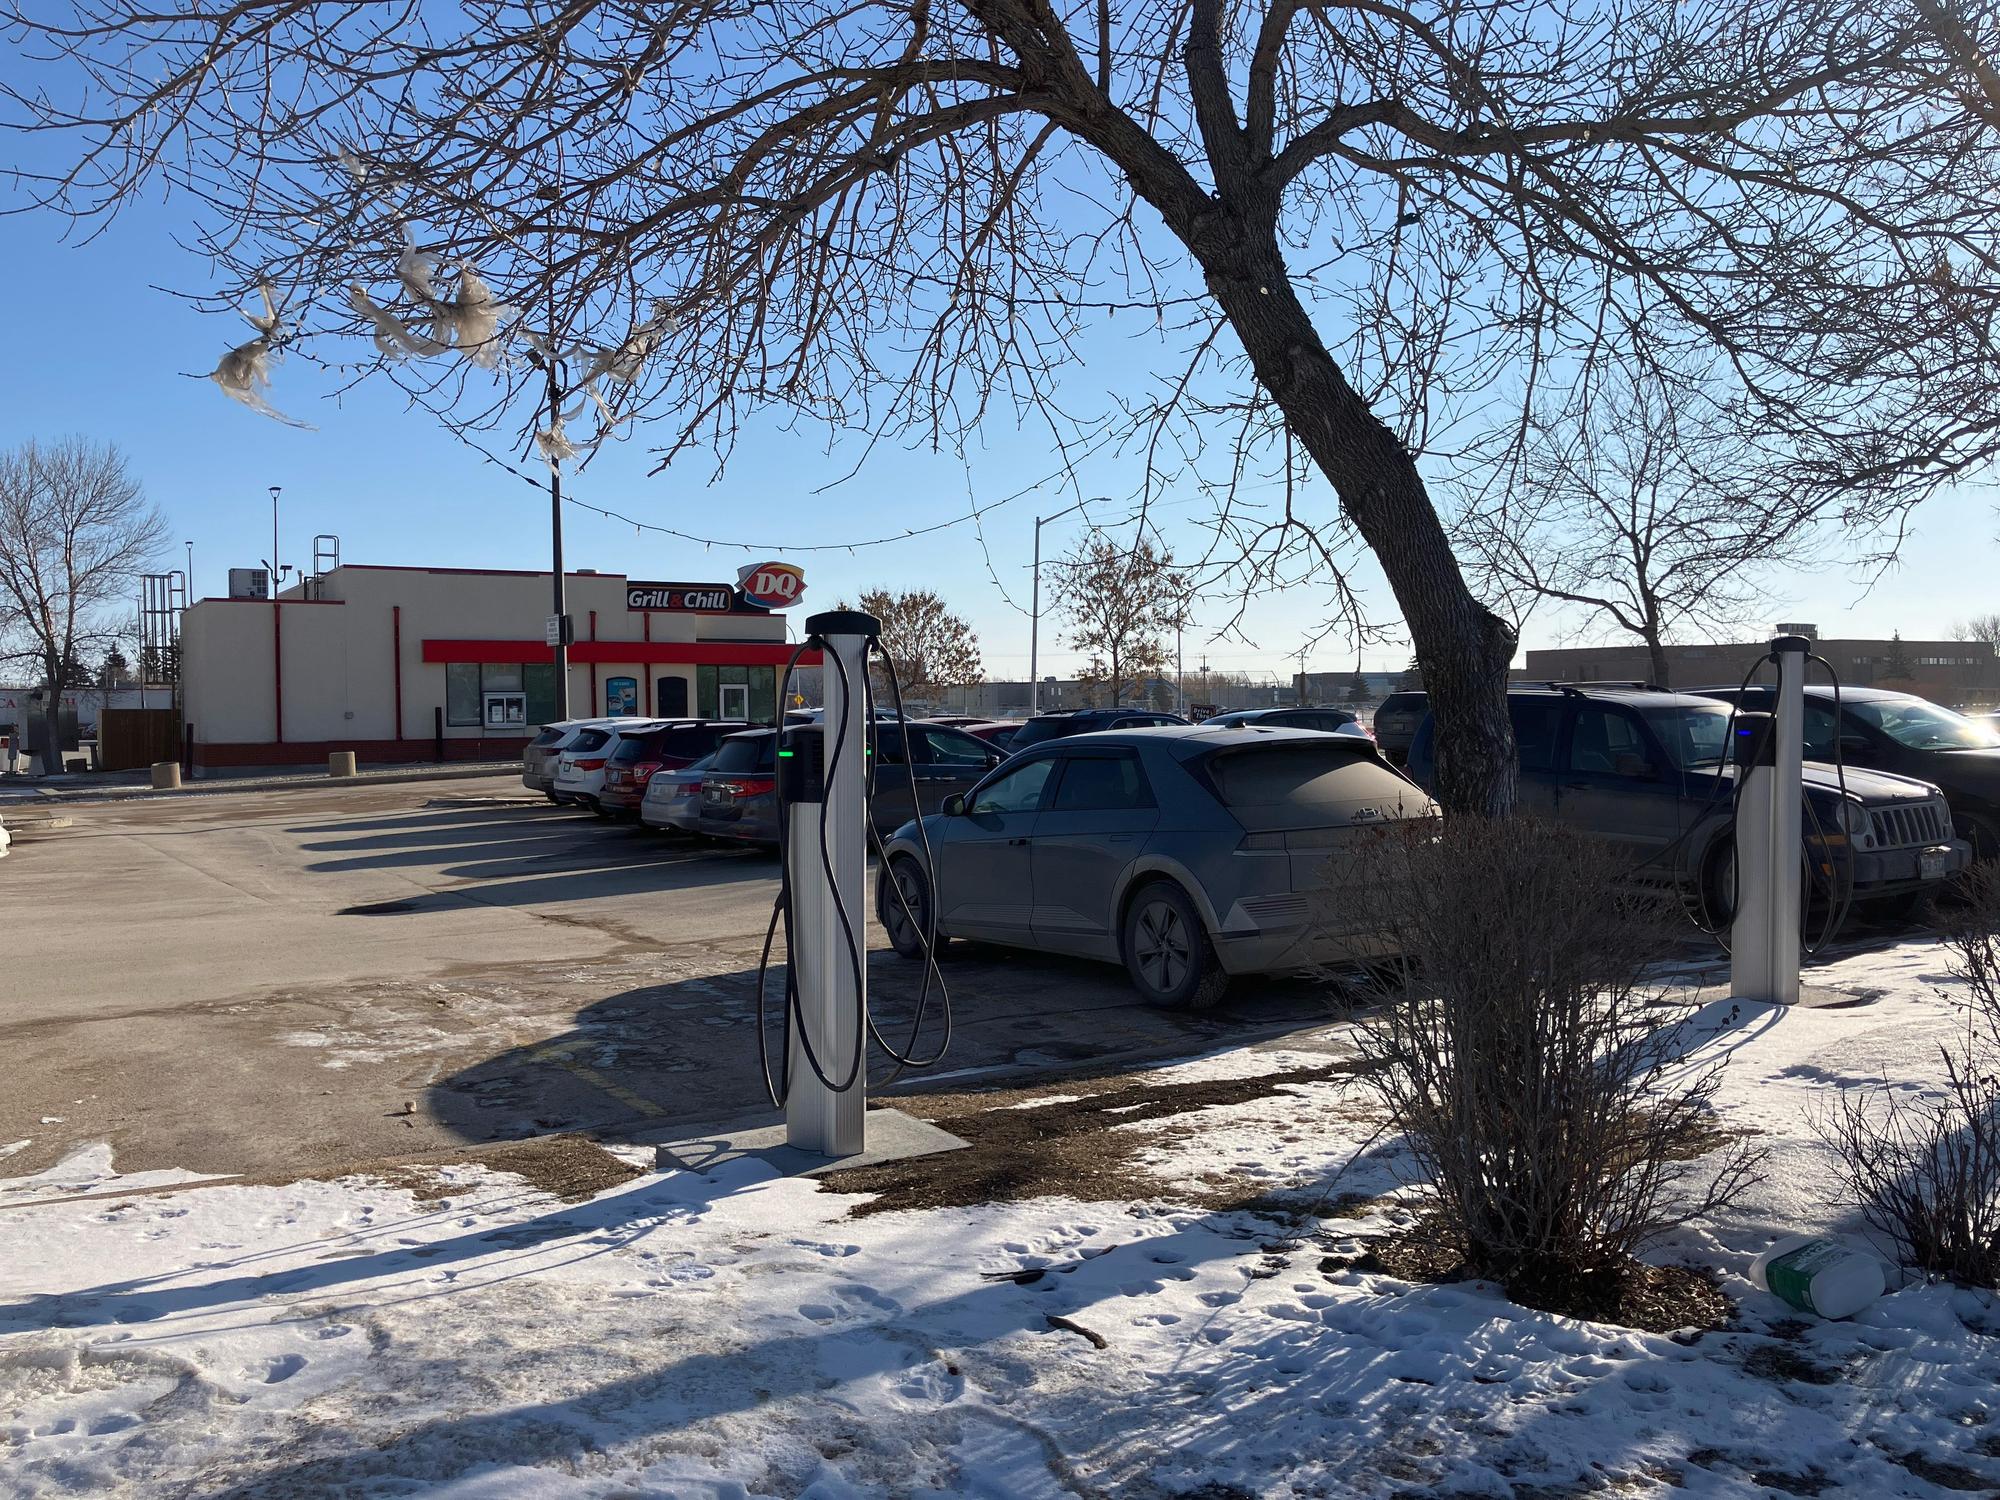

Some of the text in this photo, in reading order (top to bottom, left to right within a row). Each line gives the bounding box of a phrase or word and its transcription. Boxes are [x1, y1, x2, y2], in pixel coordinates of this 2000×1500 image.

[754, 572, 797, 599] DQ
[628, 590, 726, 609] Grill & Chill
